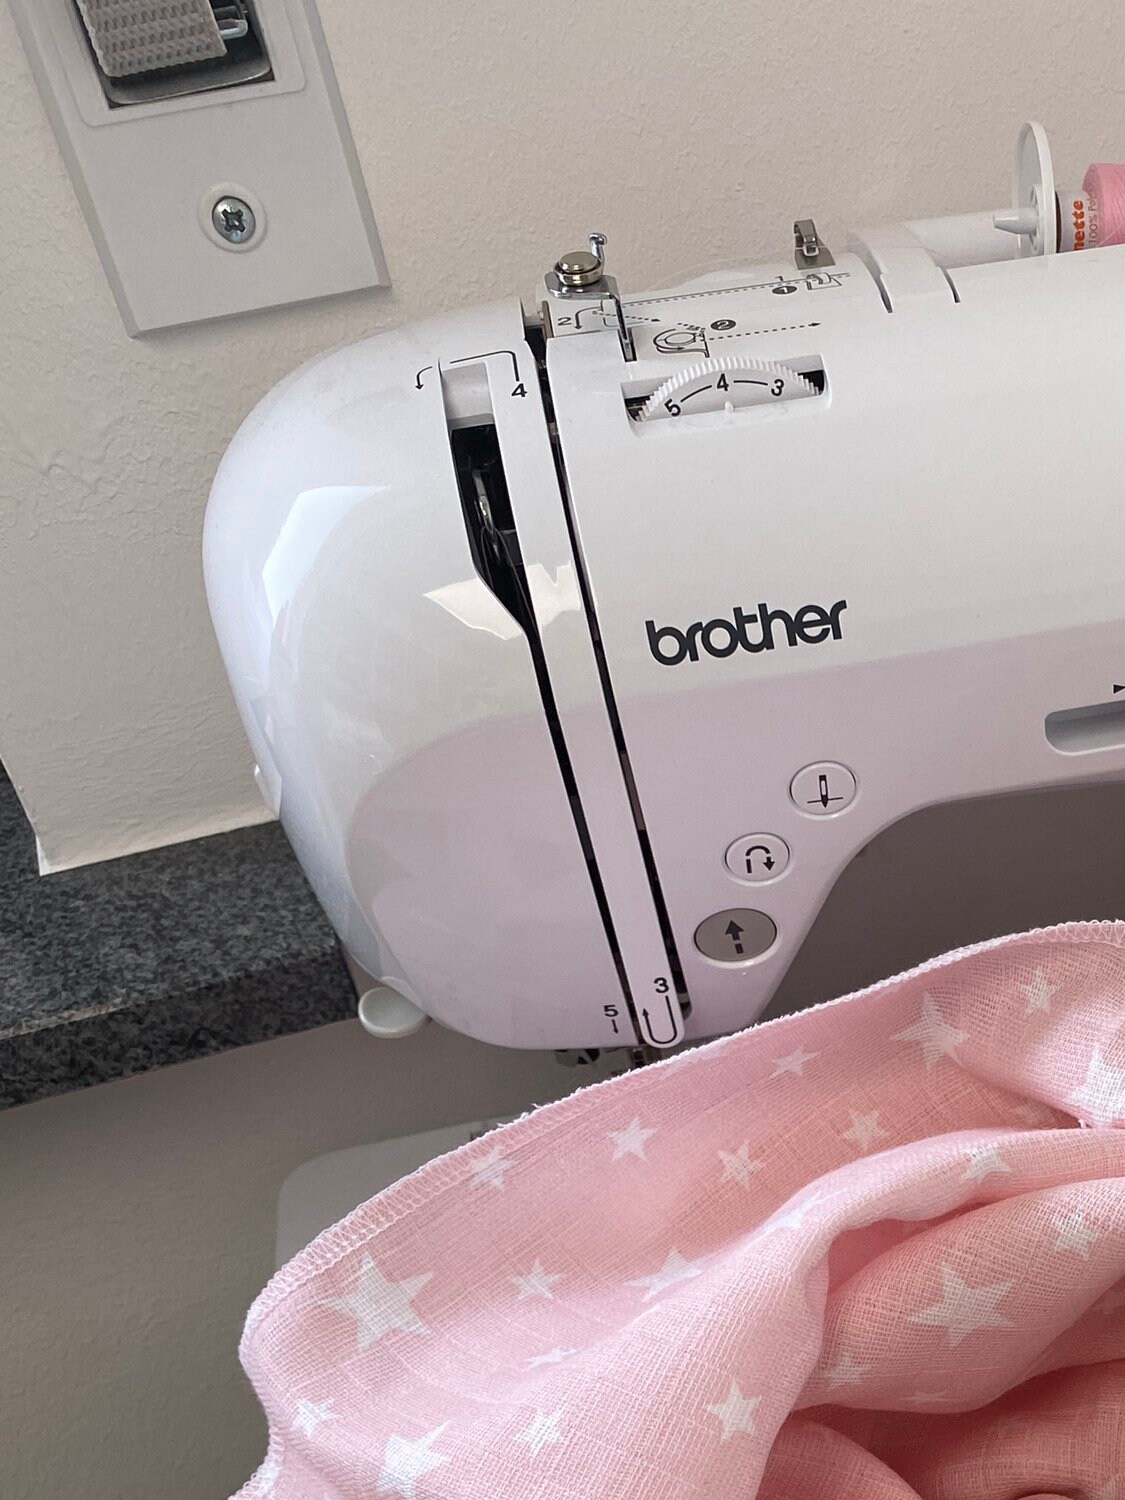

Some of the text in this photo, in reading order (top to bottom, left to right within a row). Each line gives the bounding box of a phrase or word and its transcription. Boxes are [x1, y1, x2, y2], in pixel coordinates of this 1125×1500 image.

[557, 316, 572, 328] 2
[511, 383, 528, 398] 4
[664, 373, 784, 417] 5 4 3
[645, 600, 848, 666] brother
[653, 977, 670, 993] 3
[603, 1004, 619, 1018] 5
